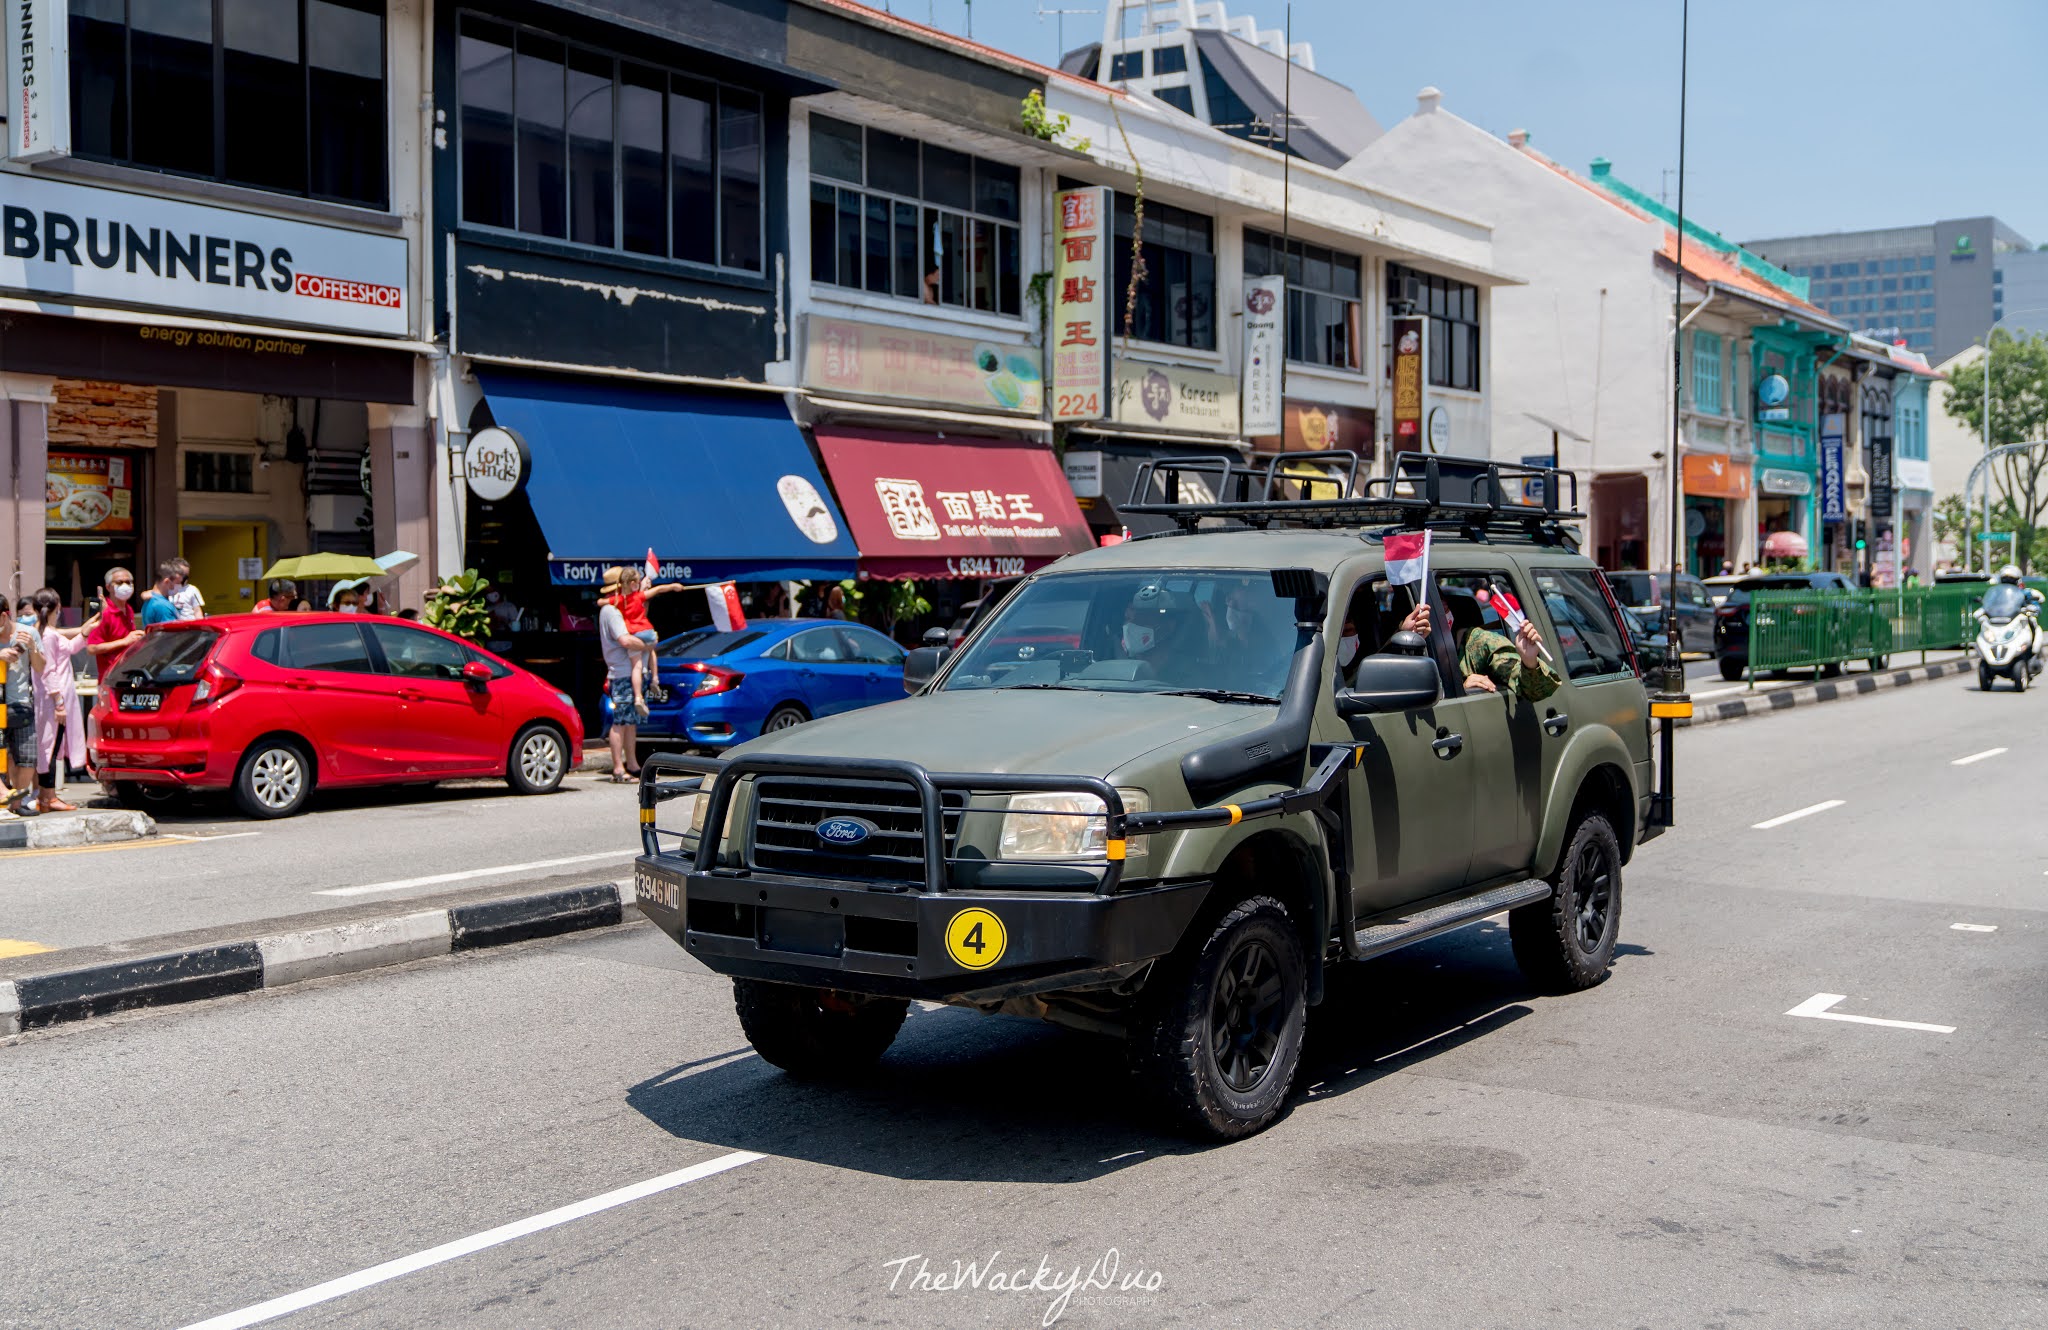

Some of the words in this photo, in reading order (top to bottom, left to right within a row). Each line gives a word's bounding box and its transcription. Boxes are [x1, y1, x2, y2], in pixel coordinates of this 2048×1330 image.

[20, 0, 34, 87] NNERS
[3, 205, 293, 293] BRUNNERS
[297, 274, 400, 307] COFFEESHOP
[139, 326, 193, 346] energy
[197, 331, 252, 349] solution
[255, 338, 306, 355] partner
[1180, 383, 1219, 402] Korean
[1058, 393, 1098, 416] 224
[1180, 402, 1219, 417] Restaurant
[477, 446, 518, 468] forty
[935, 489, 1044, 523] 面點王
[943, 524, 962, 537] Tall
[961, 525, 981, 537] Girl
[979, 525, 1014, 538] Chinese
[1013, 526, 1062, 538] Restaurant
[563, 563, 598, 583] Forty
[659, 563, 692, 578] offee
[960, 558, 992, 576] 6344
[995, 558, 1026, 576] 7002
[826, 822, 858, 839] Ford
[963, 922, 986, 955] 4
